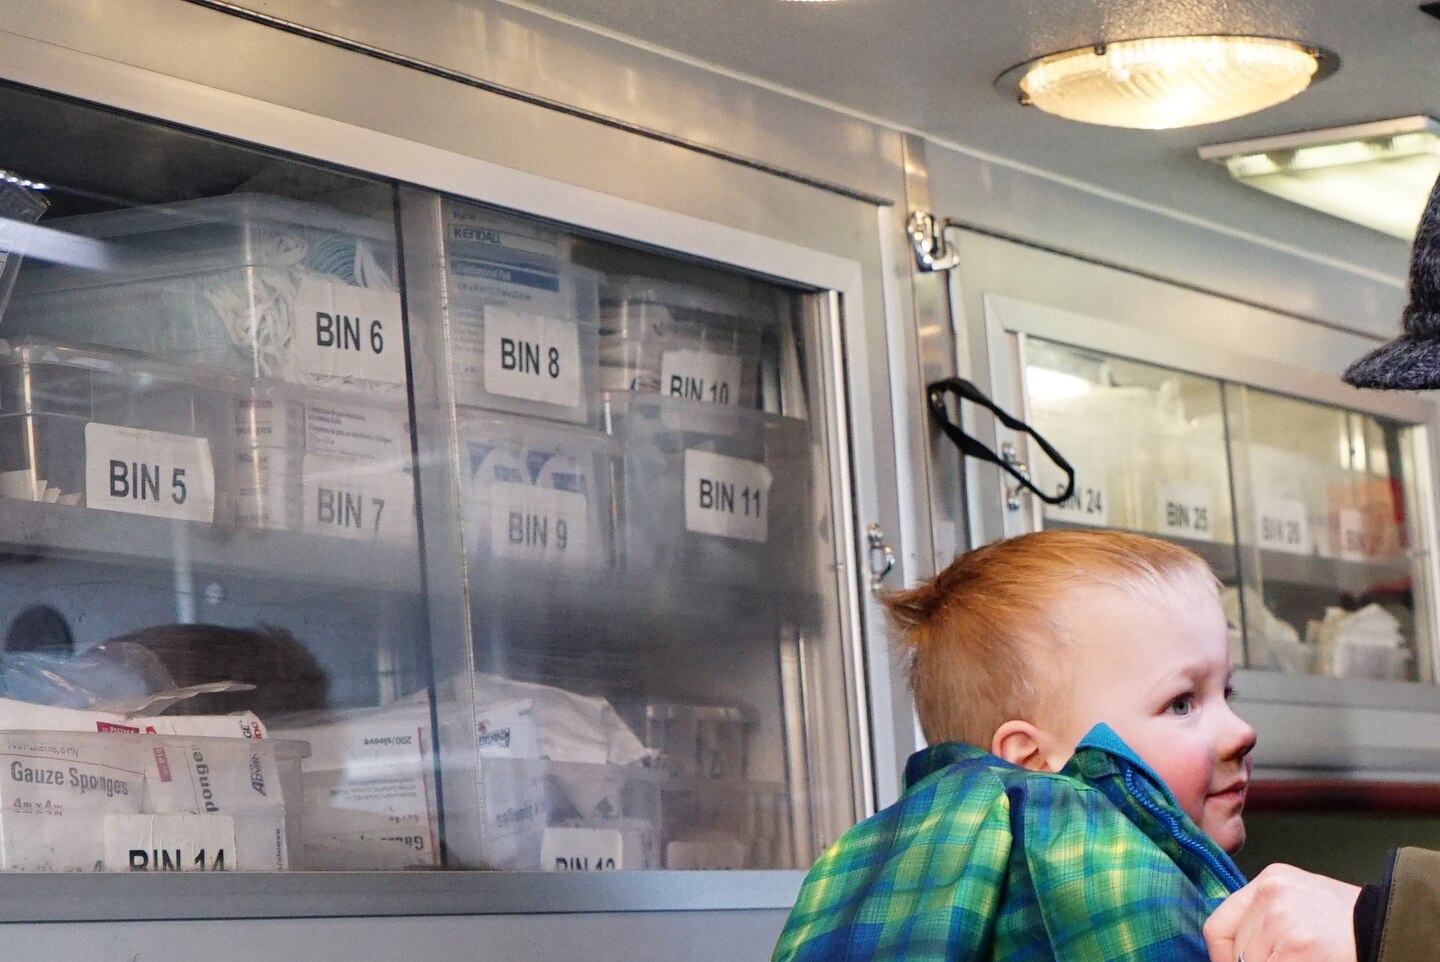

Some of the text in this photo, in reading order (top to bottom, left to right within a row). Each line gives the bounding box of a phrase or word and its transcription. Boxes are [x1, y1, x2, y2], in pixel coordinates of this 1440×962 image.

[315, 311, 384, 354] BIN 6
[500, 338, 540, 375] BIN
[548, 347, 560, 378] 8
[671, 374, 729, 405] BIN 10
[109, 459, 187, 504] BIN 5
[699, 478, 760, 518] BIN 11
[1086, 488, 1103, 515] 24
[317, 487, 385, 535] BIN 7
[1166, 501, 1189, 527] BIN
[508, 512, 568, 552] BIN 9
[10, 761, 129, 797] Gauze Sponges
[129, 849, 181, 872] BIN
